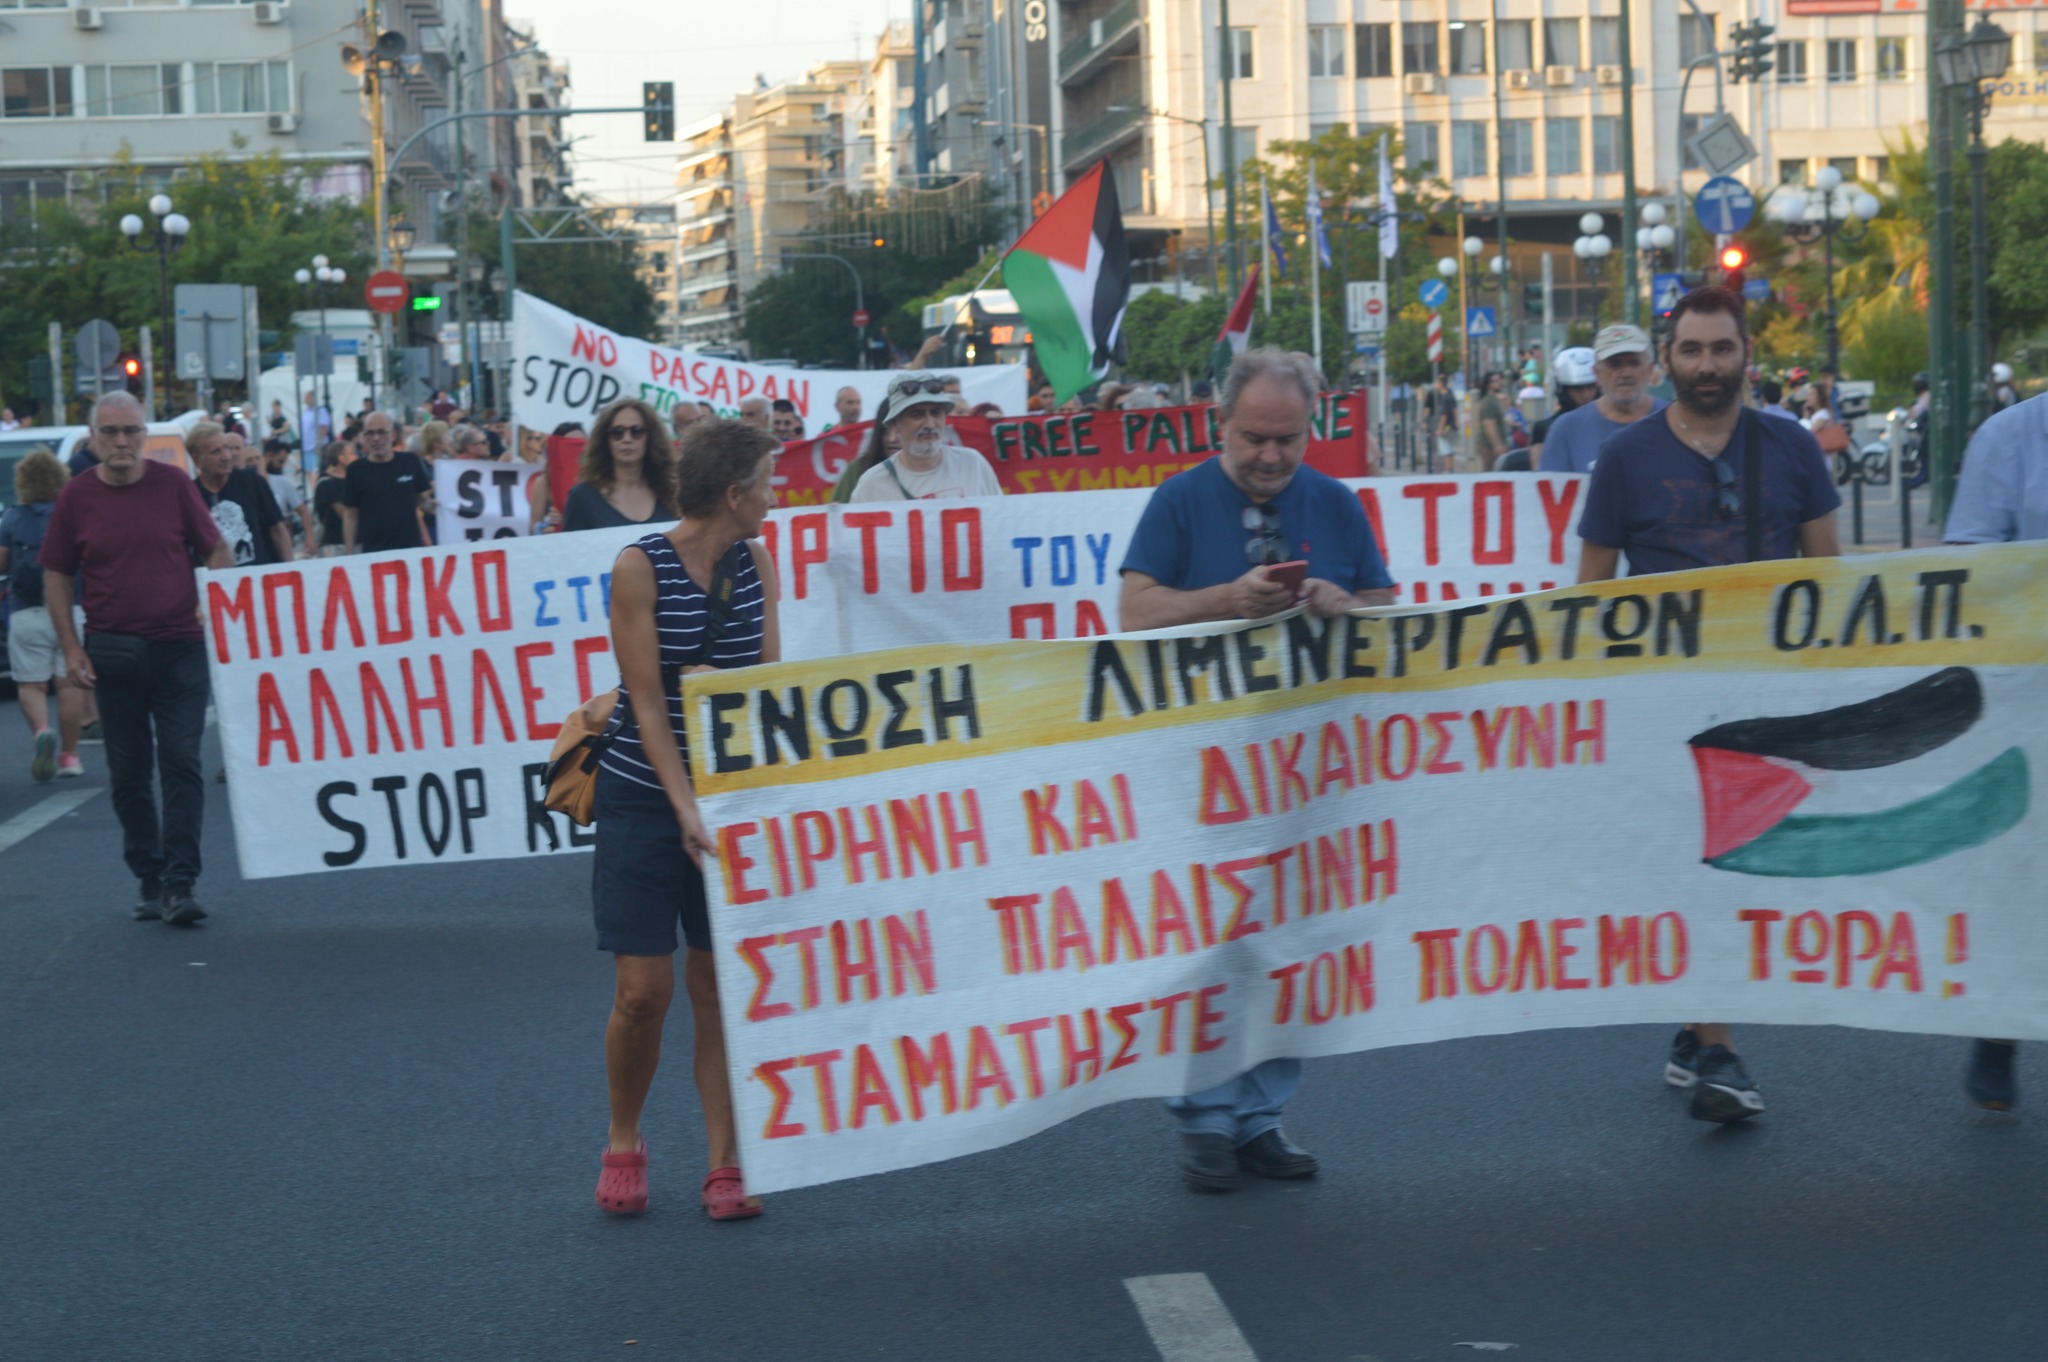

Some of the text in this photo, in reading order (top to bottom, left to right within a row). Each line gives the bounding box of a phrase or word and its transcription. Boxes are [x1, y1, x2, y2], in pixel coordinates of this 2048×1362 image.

[1025, 0, 1046, 42] OS
[524, 355, 620, 415] STOP
[572, 323, 617, 367] NO
[991, 413, 1100, 461] FREE
[1122, 391, 1353, 456] PALENE
[207, 549, 513, 664] ΜΠΛΟΚΟ
[1010, 533, 1112, 588] ΤΟΥ
[257, 635, 609, 767] ΑΛΛΗΛΕΓ
[709, 568, 1986, 774] ΕΝΩΣΗ ΛΙΜΕΝΕΡΓΑΤΩΝ Ο.Λ.Π.
[316, 767, 487, 868] STOP
[718, 698, 1606, 905] ΕΙΡΗΝΗ ΚΑΙ ΔΙΚΑΙΟΣΥΝΗ
[736, 817, 1398, 1023] ΣΤΗΝ ΠΑΛΑΙΣΤΙΝΗ
[750, 983, 1230, 1139] ΣΤΑΜΑΤΗΣΤΕ
[1270, 940, 1375, 1026] ΤΟΝ
[1413, 910, 1691, 1002] ΠΟΛΕΜΟ
